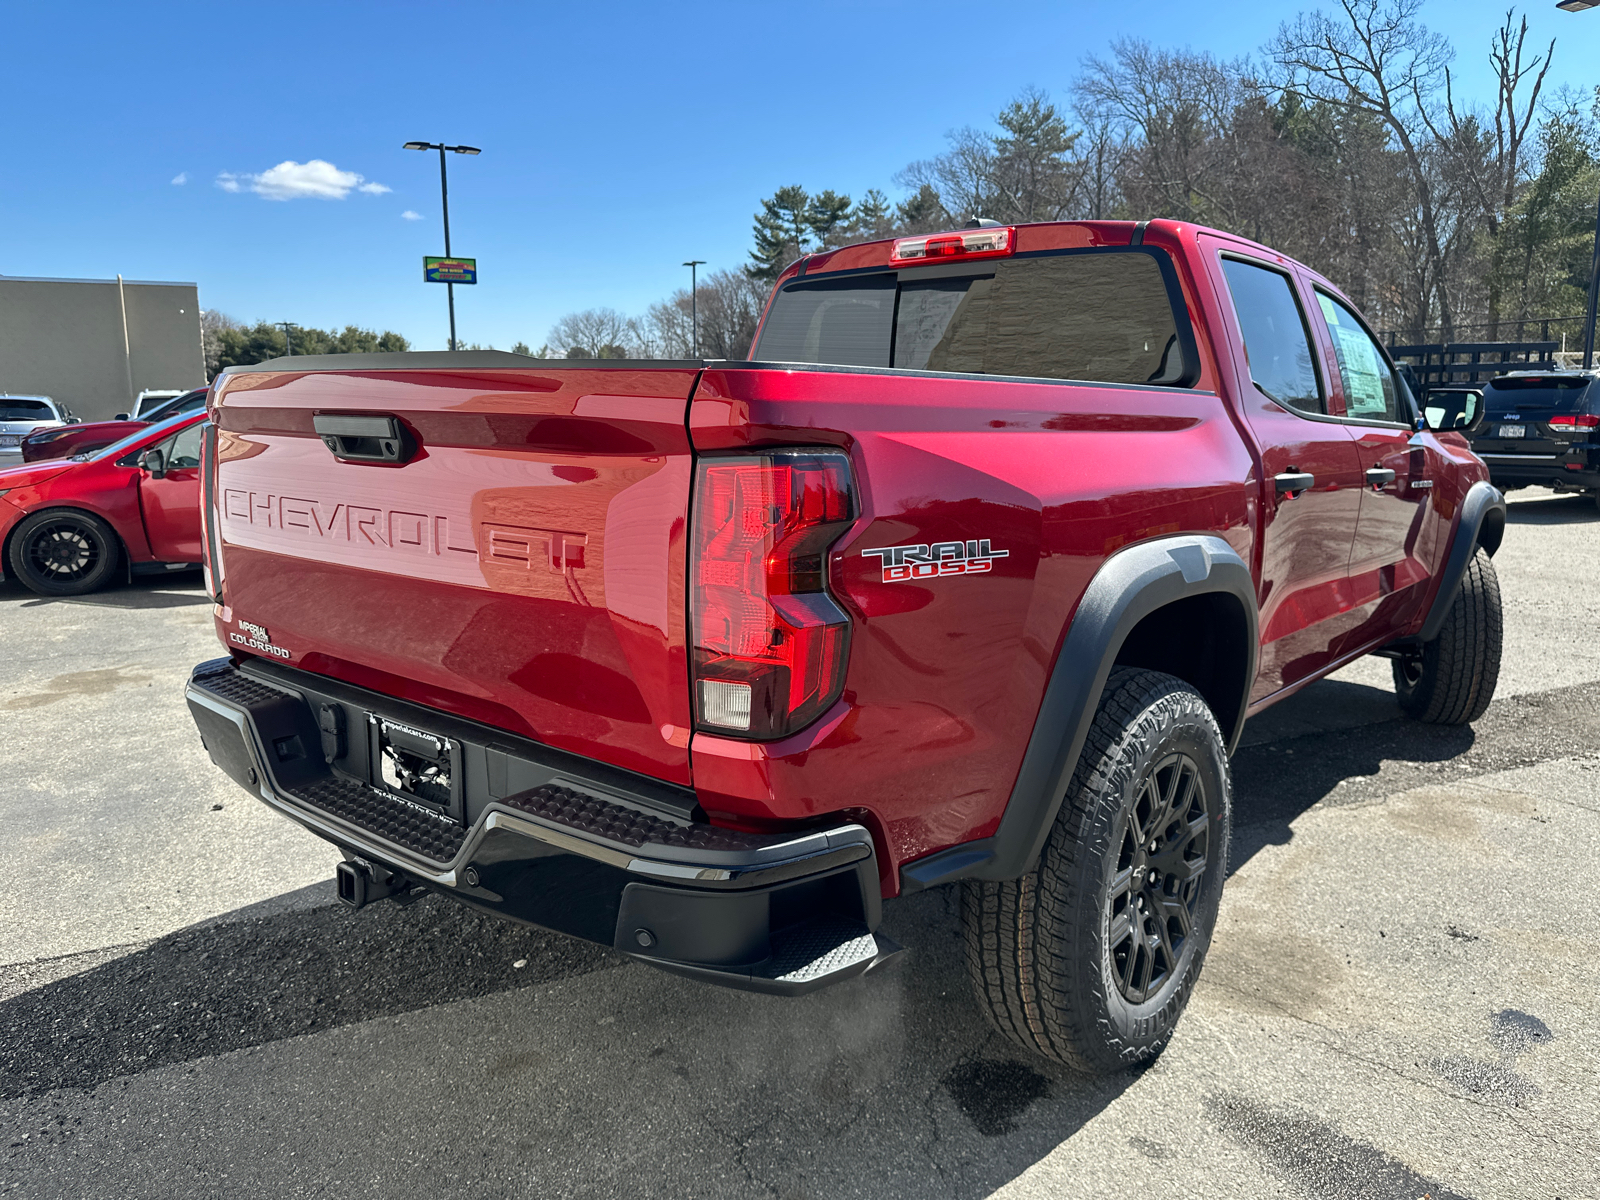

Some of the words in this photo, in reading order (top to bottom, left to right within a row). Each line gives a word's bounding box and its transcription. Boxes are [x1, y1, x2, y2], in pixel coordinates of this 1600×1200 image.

[225, 488, 588, 575] CHEVROLET
[861, 538, 1010, 567] TRAIL
[882, 556, 993, 583] BOSS
[238, 619, 267, 634] IMPERIAL
[230, 632, 290, 659] COLORADO
